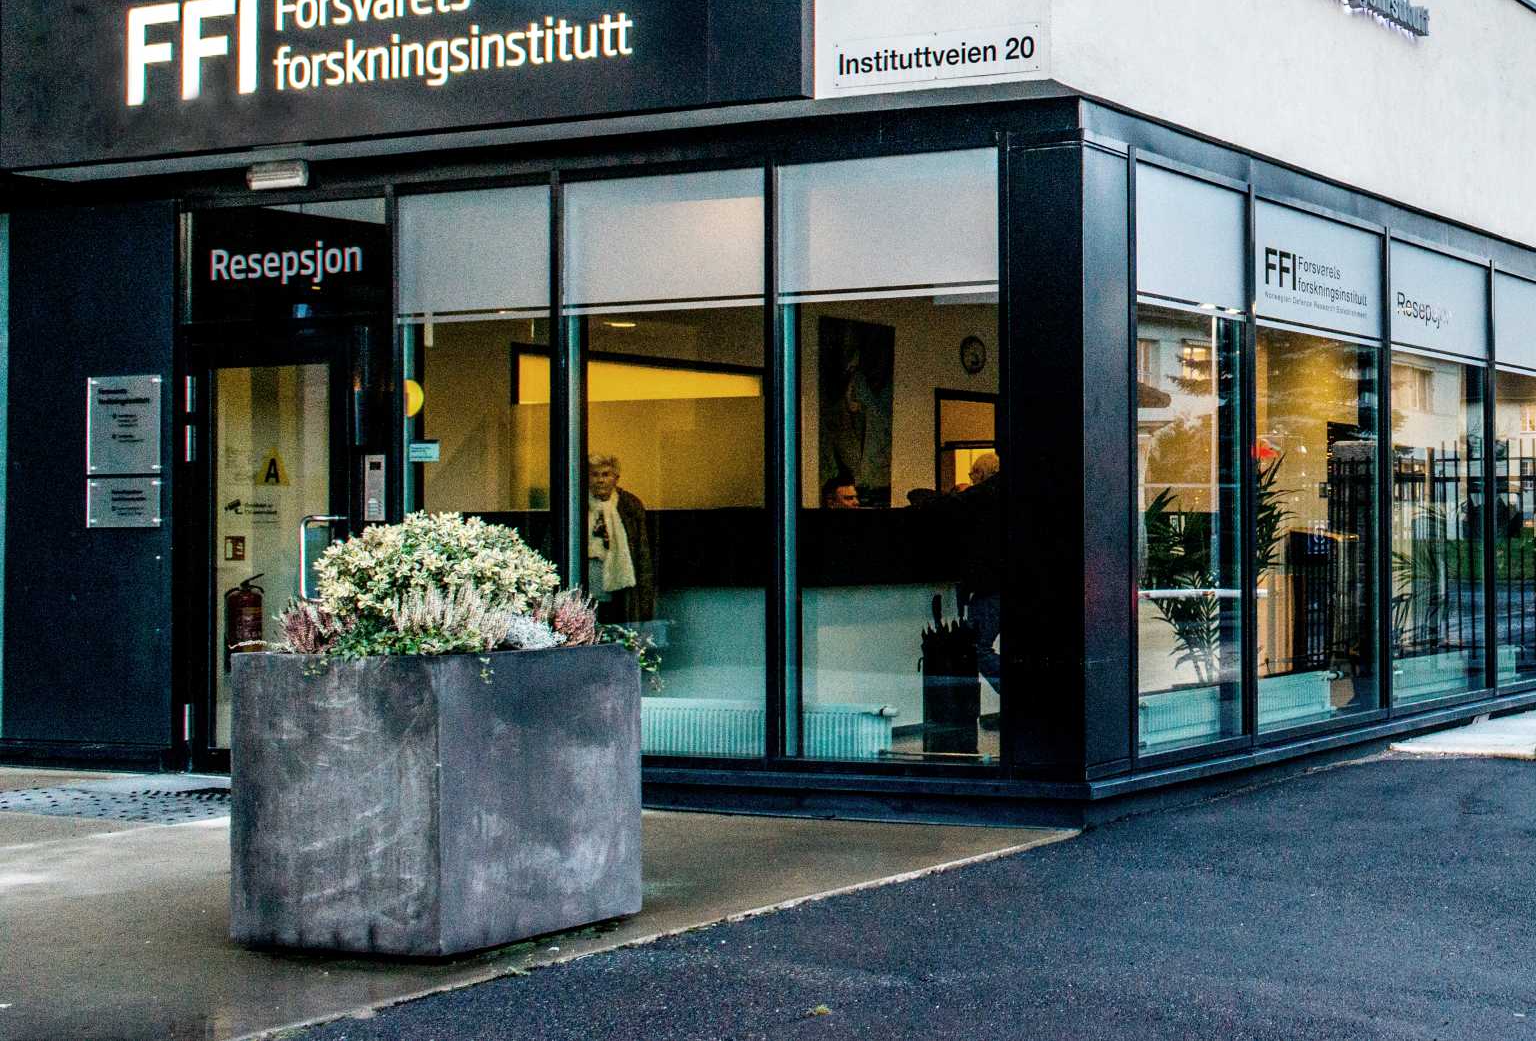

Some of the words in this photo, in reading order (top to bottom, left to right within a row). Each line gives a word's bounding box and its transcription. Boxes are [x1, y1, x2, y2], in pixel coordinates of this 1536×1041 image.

[273, 11, 634, 89] forskningsinstitutt
[838, 41, 997, 76] Instituttveien
[1005, 35, 1036, 60] 20
[210, 240, 363, 285] Resepsjon
[1265, 247, 1296, 291] FFI
[1298, 256, 1341, 280] Forsvarets
[1297, 277, 1368, 307] forskningsinstitutt
[264, 457, 280, 484] A
